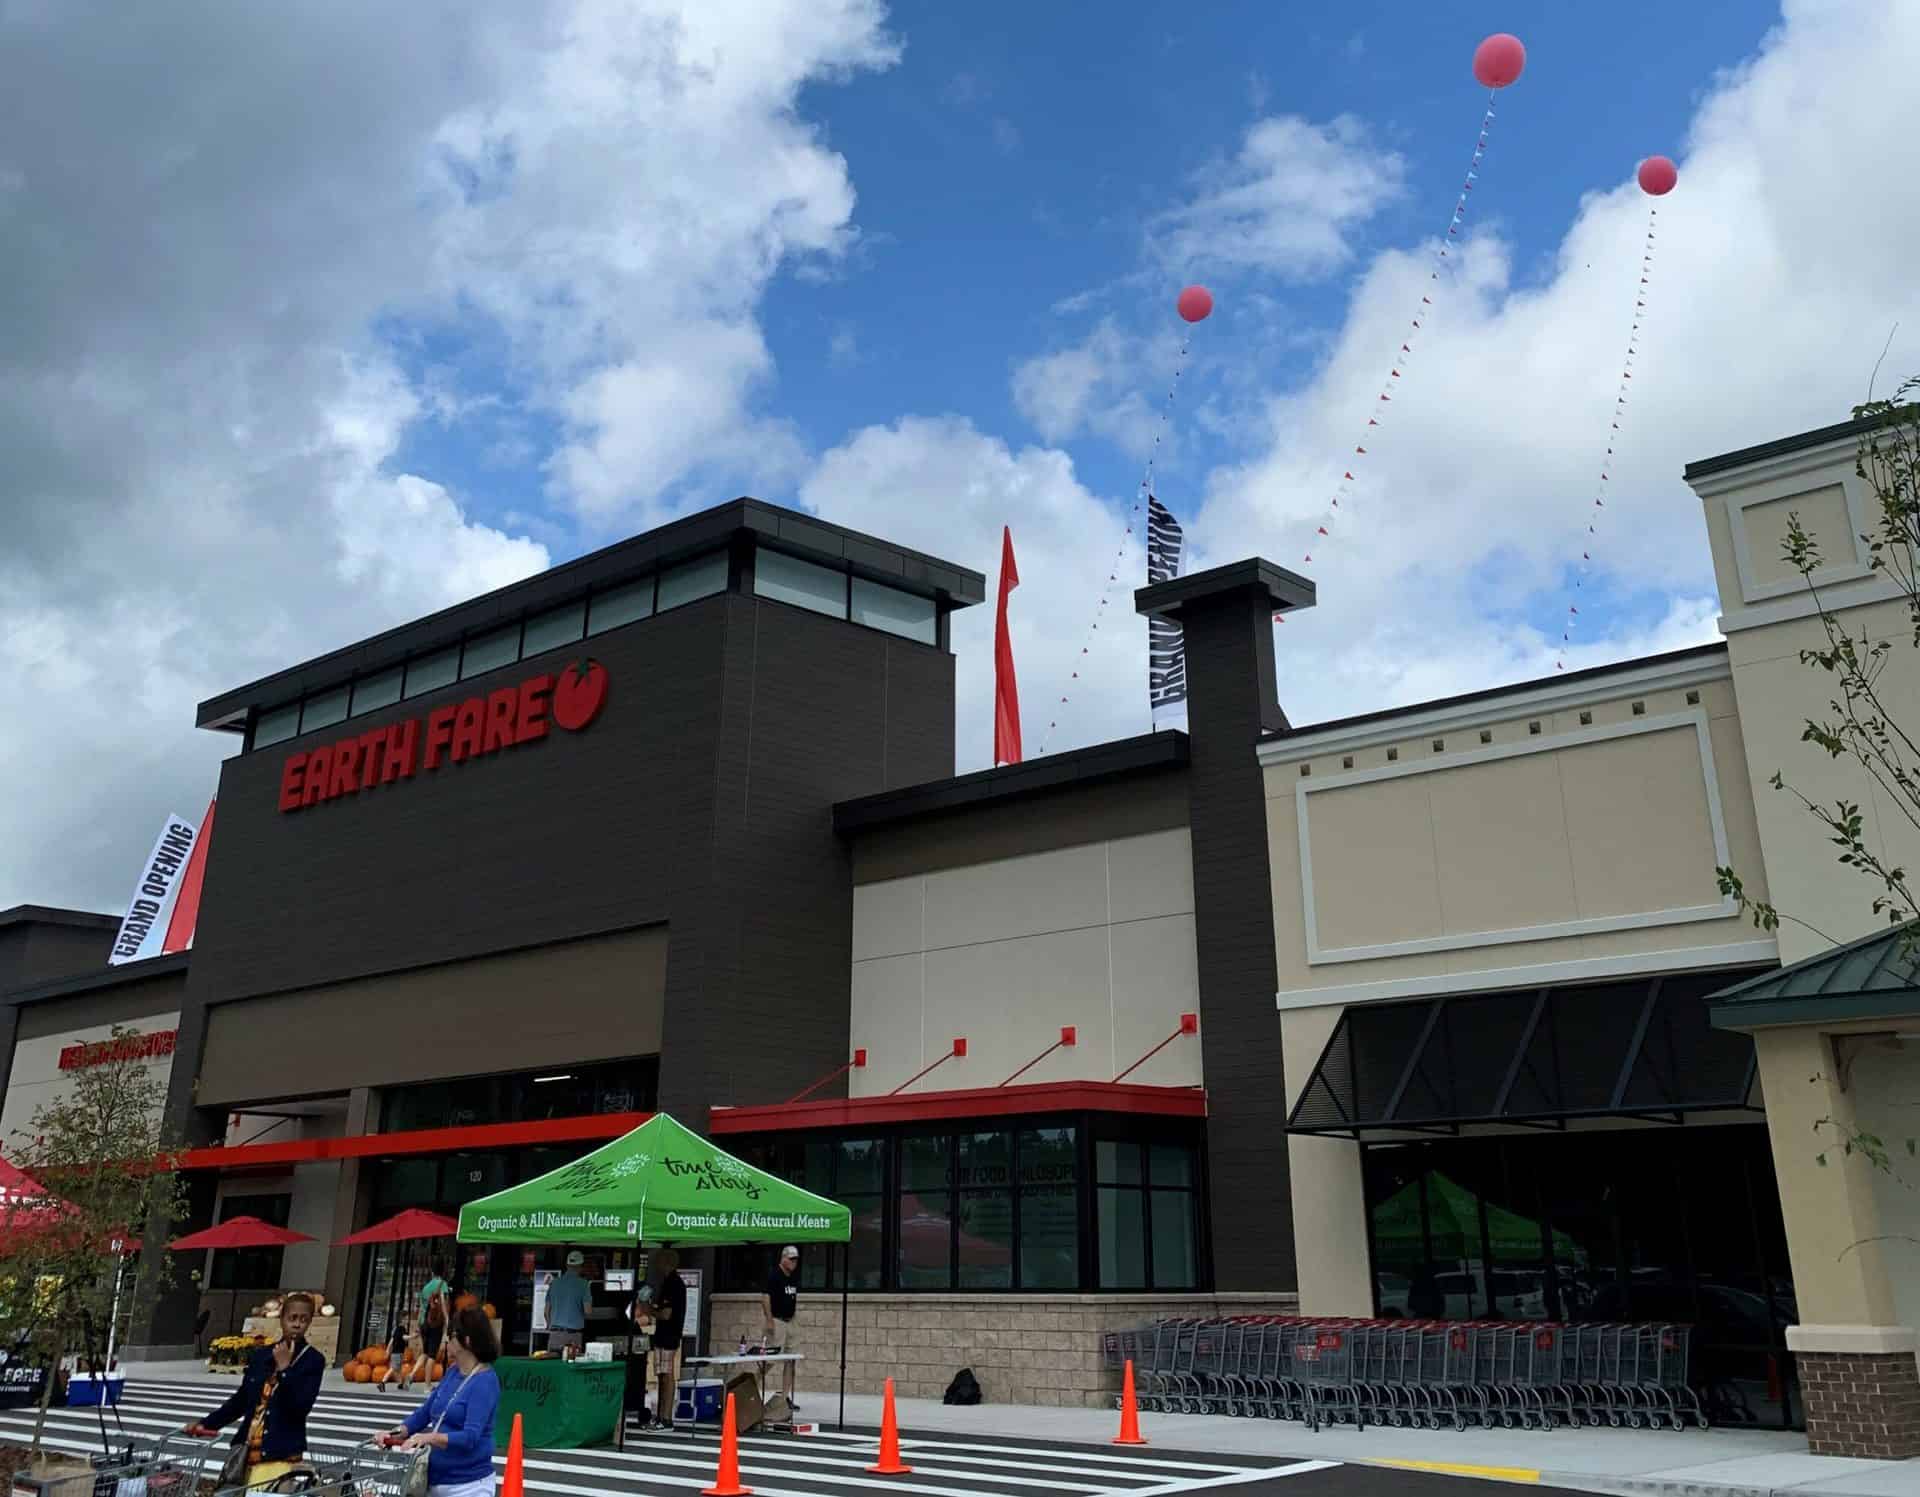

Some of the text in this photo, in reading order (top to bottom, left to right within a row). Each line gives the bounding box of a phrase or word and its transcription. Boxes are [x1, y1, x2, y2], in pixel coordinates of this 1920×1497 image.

[1148, 494, 1182, 586] PENIN
[279, 672, 553, 813] EARTH FARE
[114, 823, 193, 957] GRAND OPENING
[469, 1170, 482, 1182] 120
[657, 1157, 722, 1176] true
[478, 1211, 620, 1232] Organic & All Natural Meats
[666, 1211, 830, 1230] Organic & All Natural Meats
